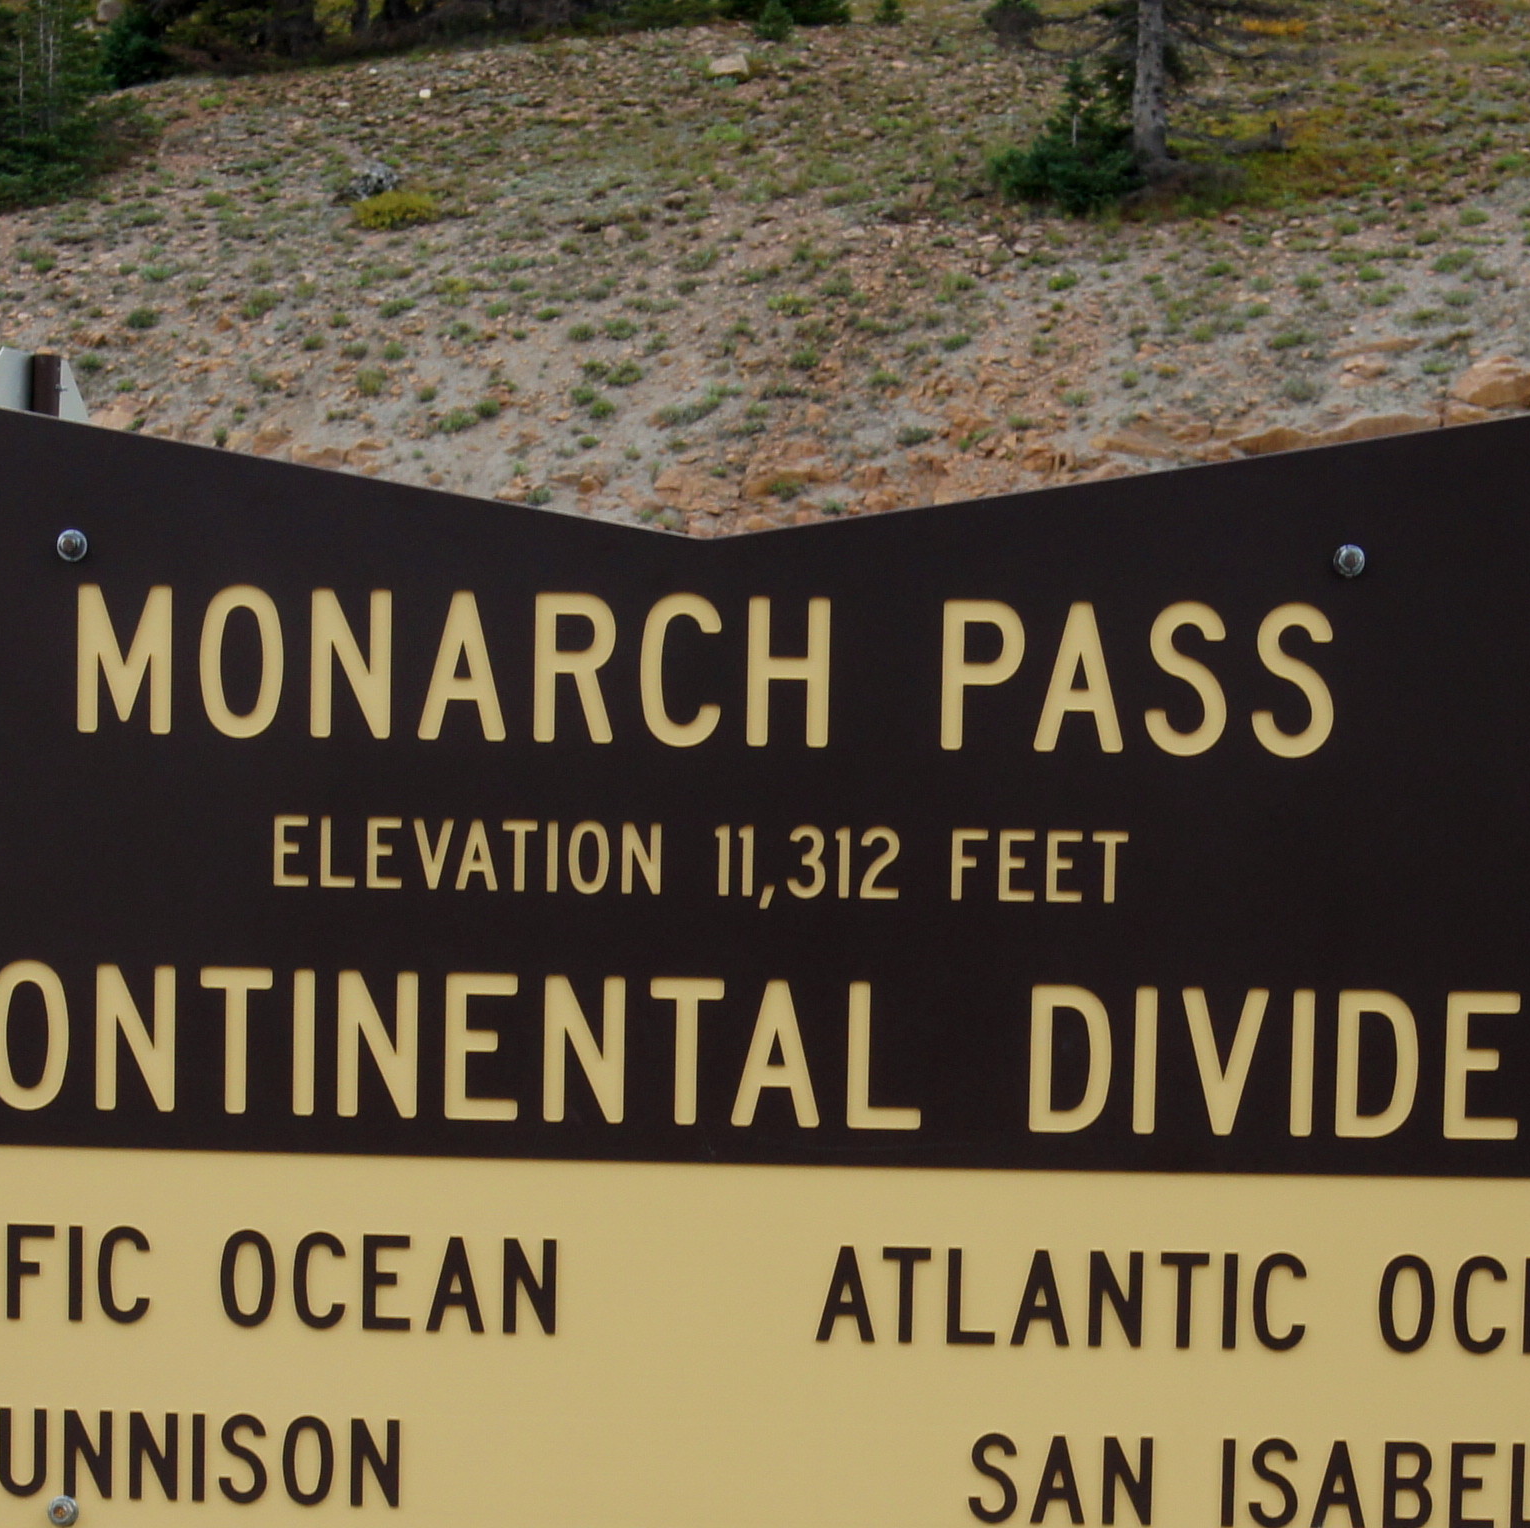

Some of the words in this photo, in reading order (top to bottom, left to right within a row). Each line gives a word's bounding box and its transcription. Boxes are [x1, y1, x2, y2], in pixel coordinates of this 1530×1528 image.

[75, 583, 832, 749] MONARCH
[939, 599, 1335, 760] PASS
[272, 814, 663, 896] ELEVATION
[713, 824, 901, 911] 11,312
[949, 828, 1130, 904] FEET
[1027, 984, 1522, 1141] DIVIDE
[218, 1228, 559, 1337] OCEAN
[814, 1244, 1309, 1354] ATLANTIC
[967, 1431, 1155, 1528] SAN
